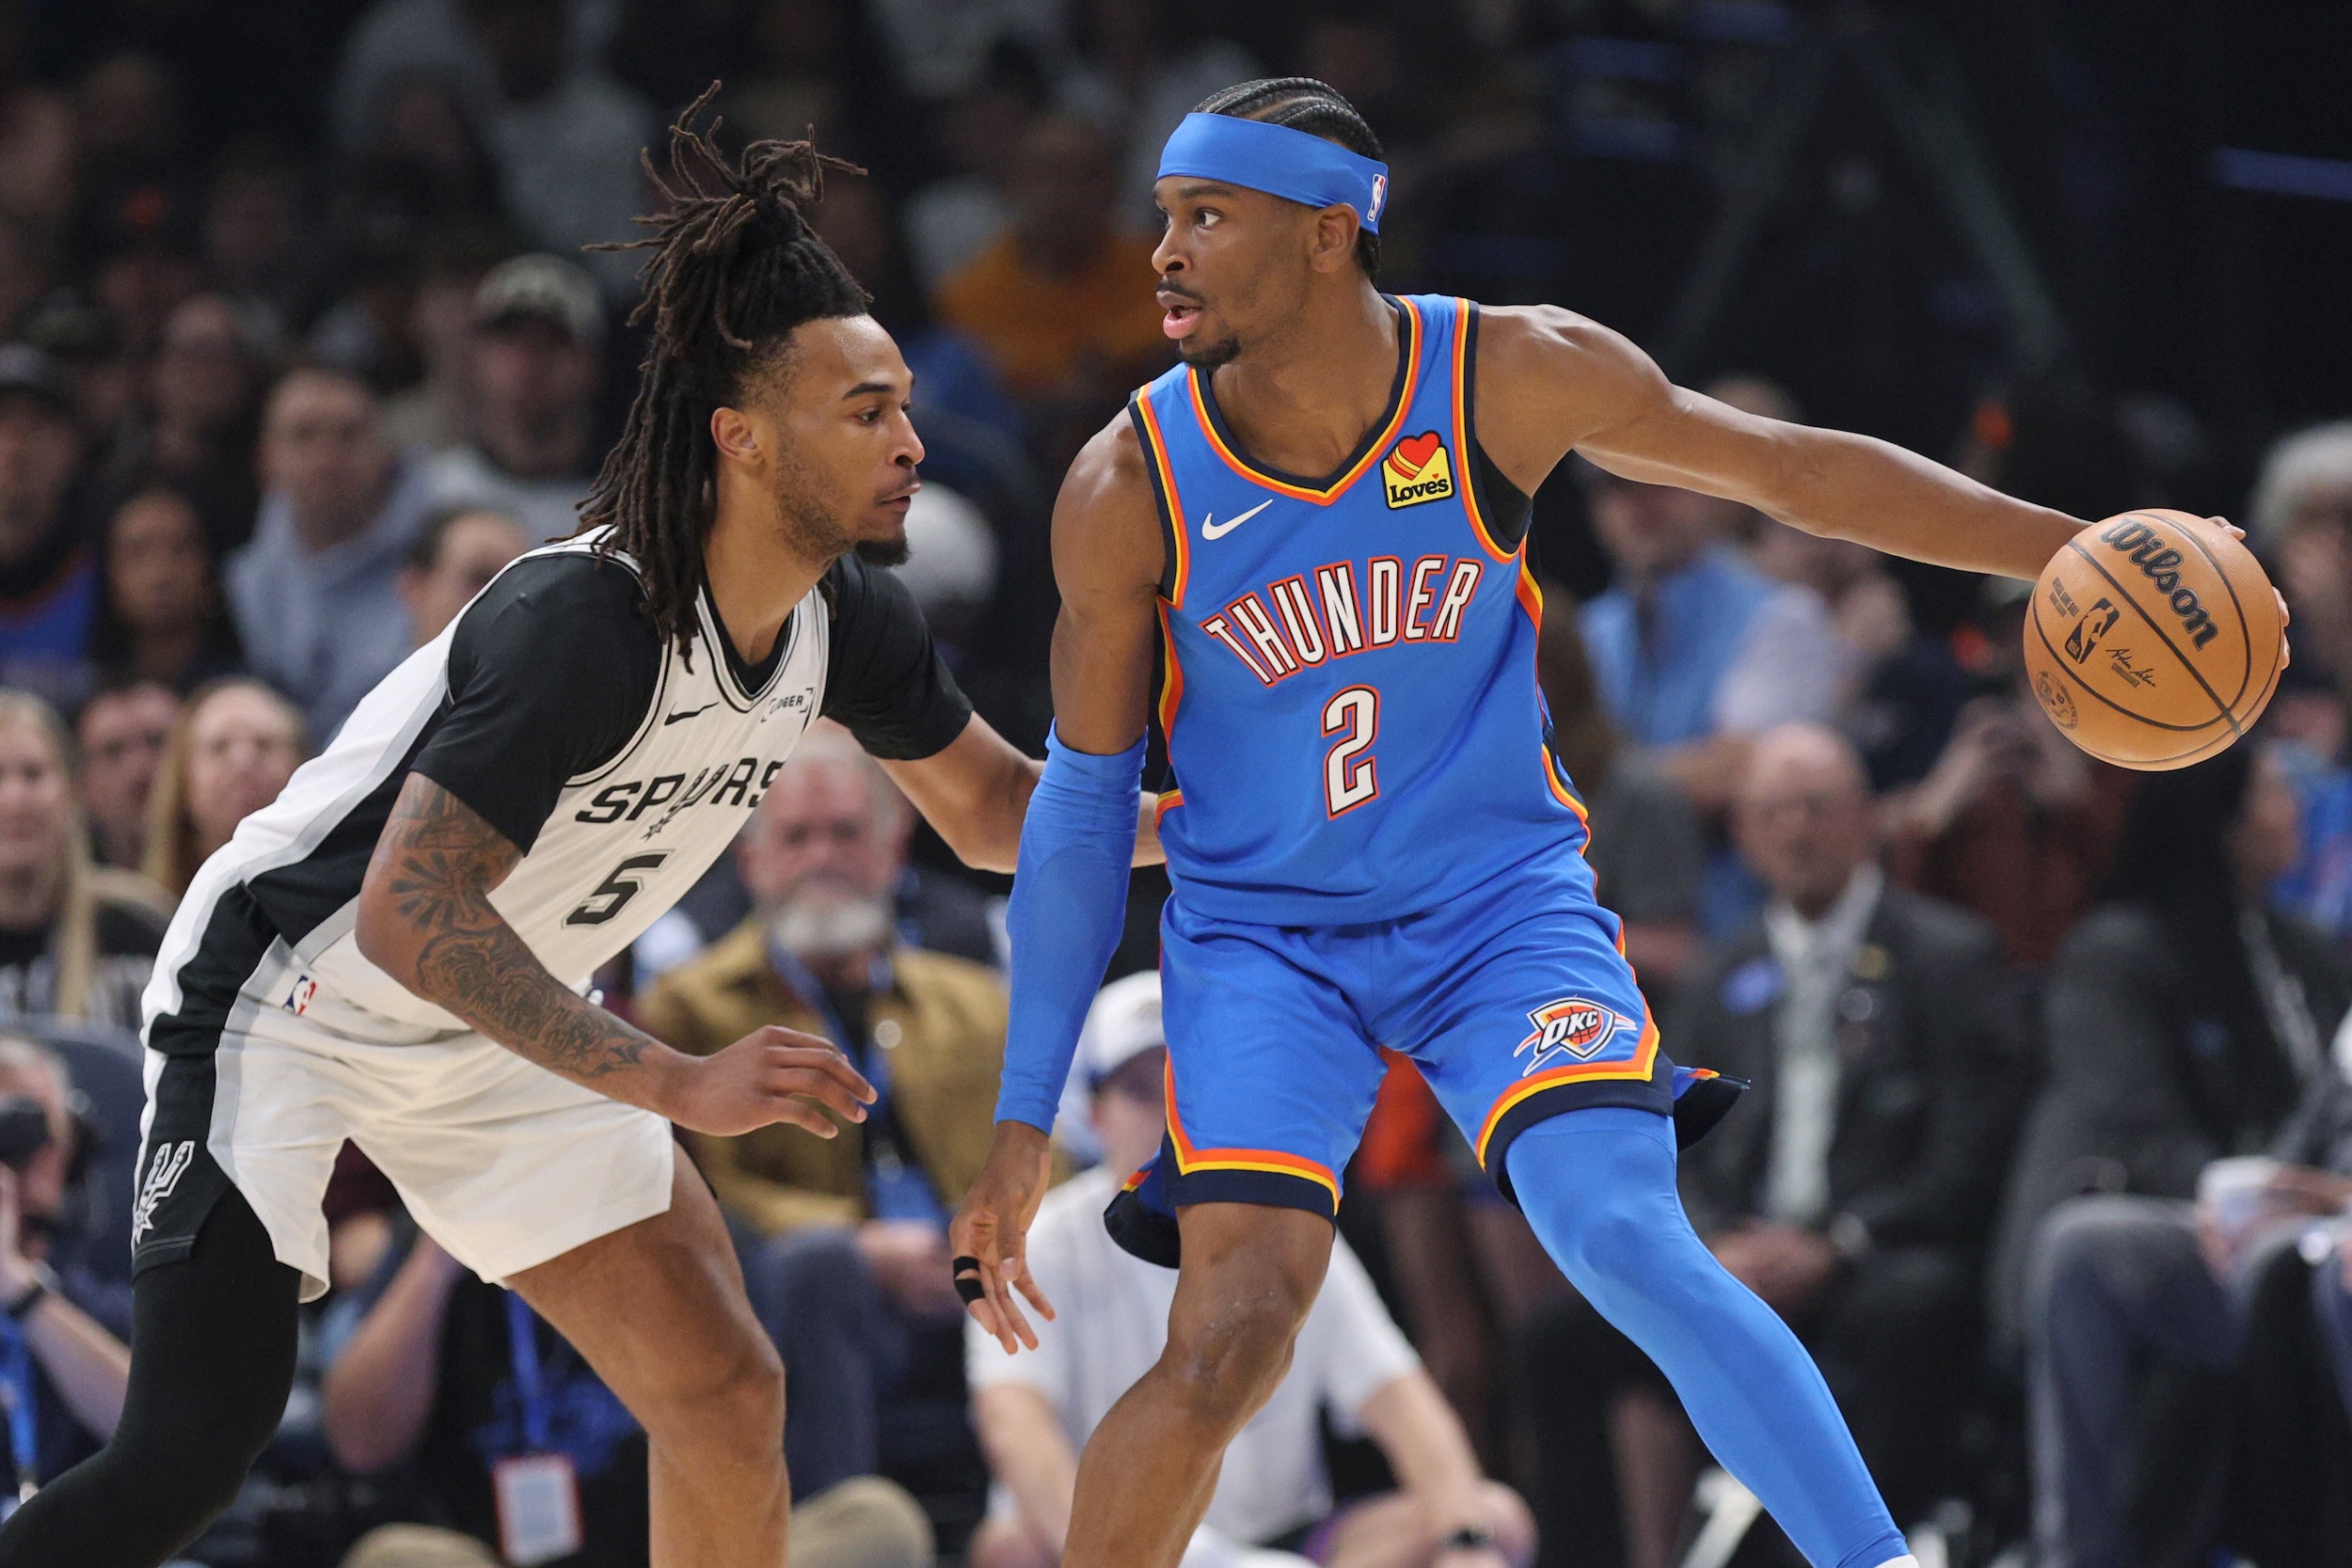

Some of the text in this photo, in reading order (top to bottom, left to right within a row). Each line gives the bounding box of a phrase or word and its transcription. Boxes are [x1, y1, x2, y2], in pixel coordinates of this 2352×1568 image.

[1199, 554, 1484, 688] THUNDER
[2100, 517, 2218, 651] Wilson
[575, 757, 787, 842] SPURS
[1321, 684, 1380, 820] 2
[562, 848, 676, 929] 5
[1538, 1009, 1599, 1053] OKC
